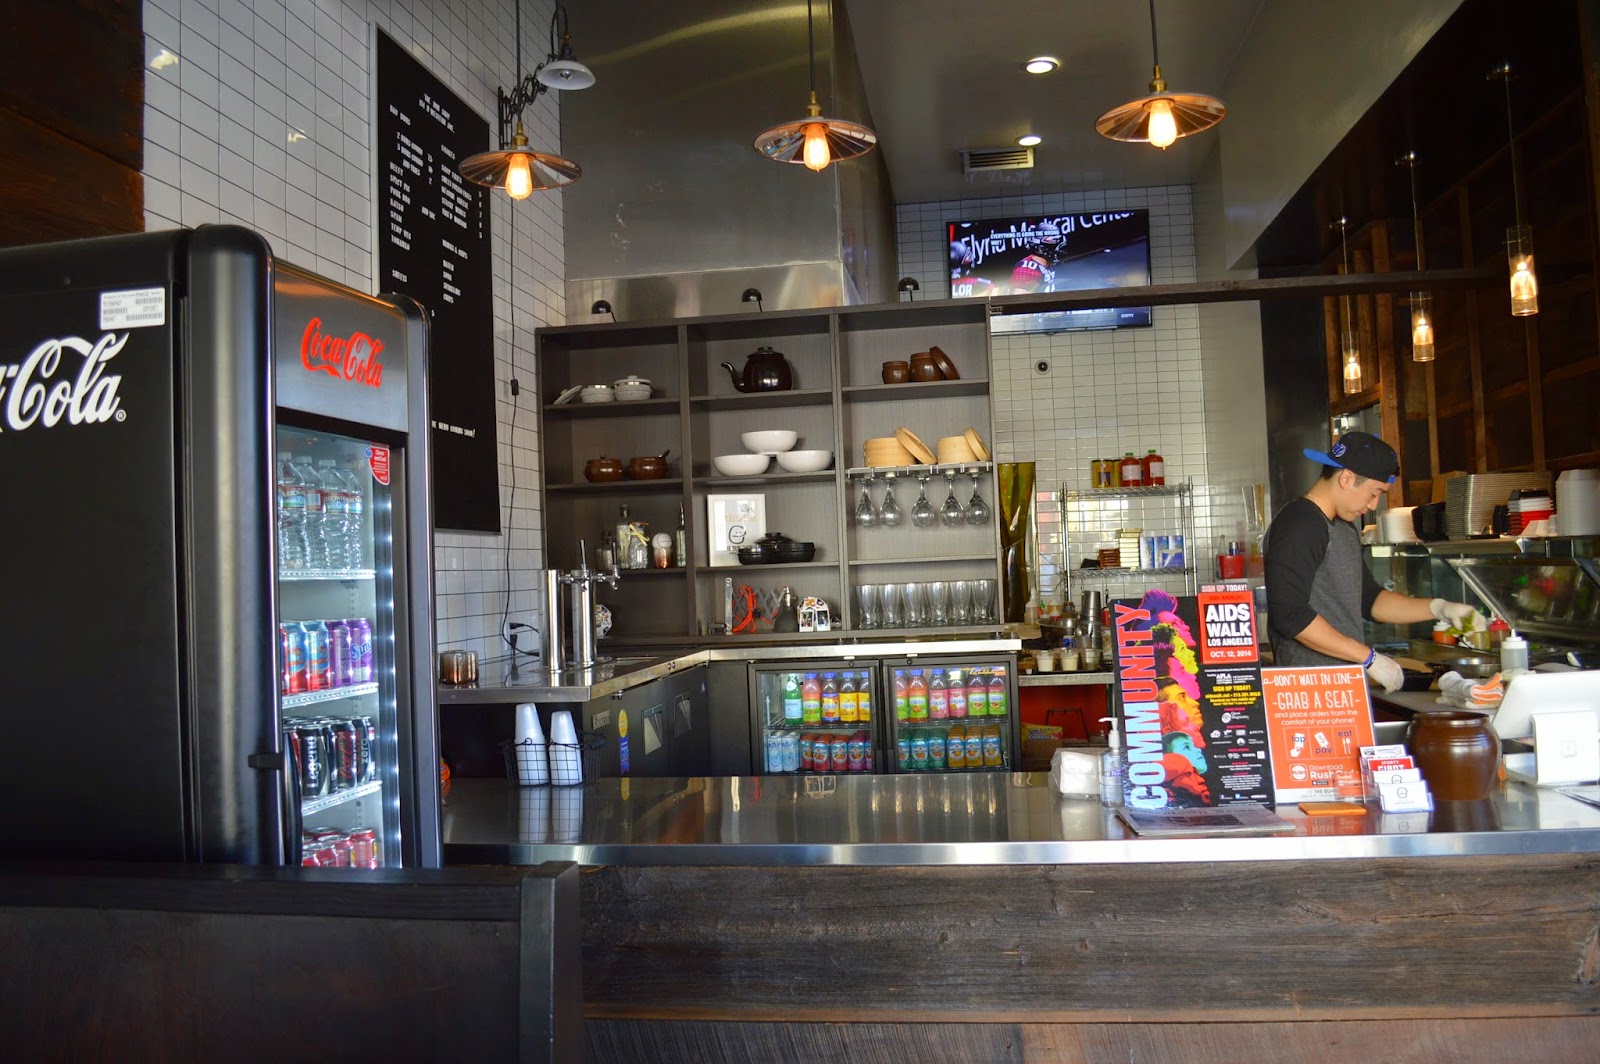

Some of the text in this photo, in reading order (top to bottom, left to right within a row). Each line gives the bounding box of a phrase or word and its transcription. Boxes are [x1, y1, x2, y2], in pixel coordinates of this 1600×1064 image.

[1206, 604, 1250, 622] AIDS
[1206, 622, 1252, 637] WALK
[1208, 637, 1253, 646] LOS ANGELES
[1274, 672, 1351, 686] DON'T WAIT IN LINE
[1277, 690, 1354, 710] GRAB A SEAT
[1291, 735, 1306, 745] tap
[1315, 747, 1332, 755] pay
